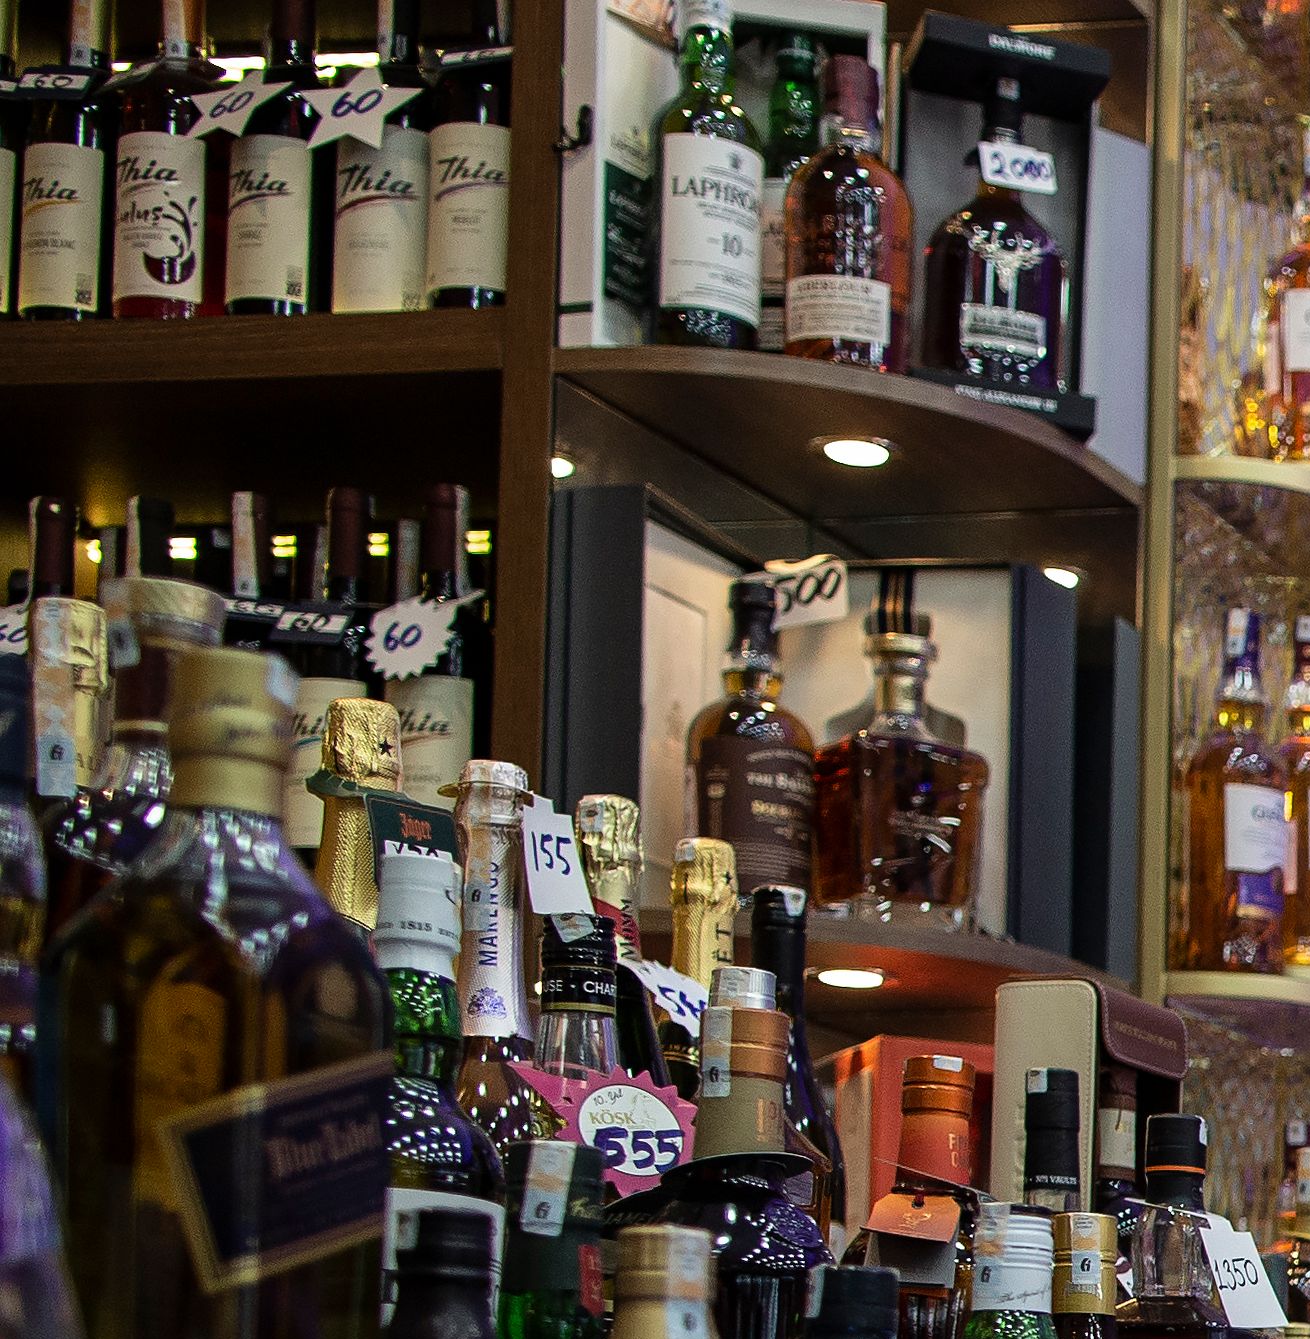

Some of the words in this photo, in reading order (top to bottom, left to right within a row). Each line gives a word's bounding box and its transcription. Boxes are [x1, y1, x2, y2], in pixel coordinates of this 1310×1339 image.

[35, 76, 72, 89] 60
[209, 91, 254, 119] 60
[331, 89, 383, 117] 60
[117, 157, 178, 182] Thia
[230, 169, 288, 192] Thia
[341, 164, 415, 195] Thia
[437, 155, 507, 182] Thia
[24, 177, 79, 200] Thia
[720, 232, 742, 257] 10
[383, 622, 422, 651] 60
[530, 831, 572, 876] 155
[593, 1126, 685, 1174] 555
[1213, 1256, 1259, 1291] 1350
